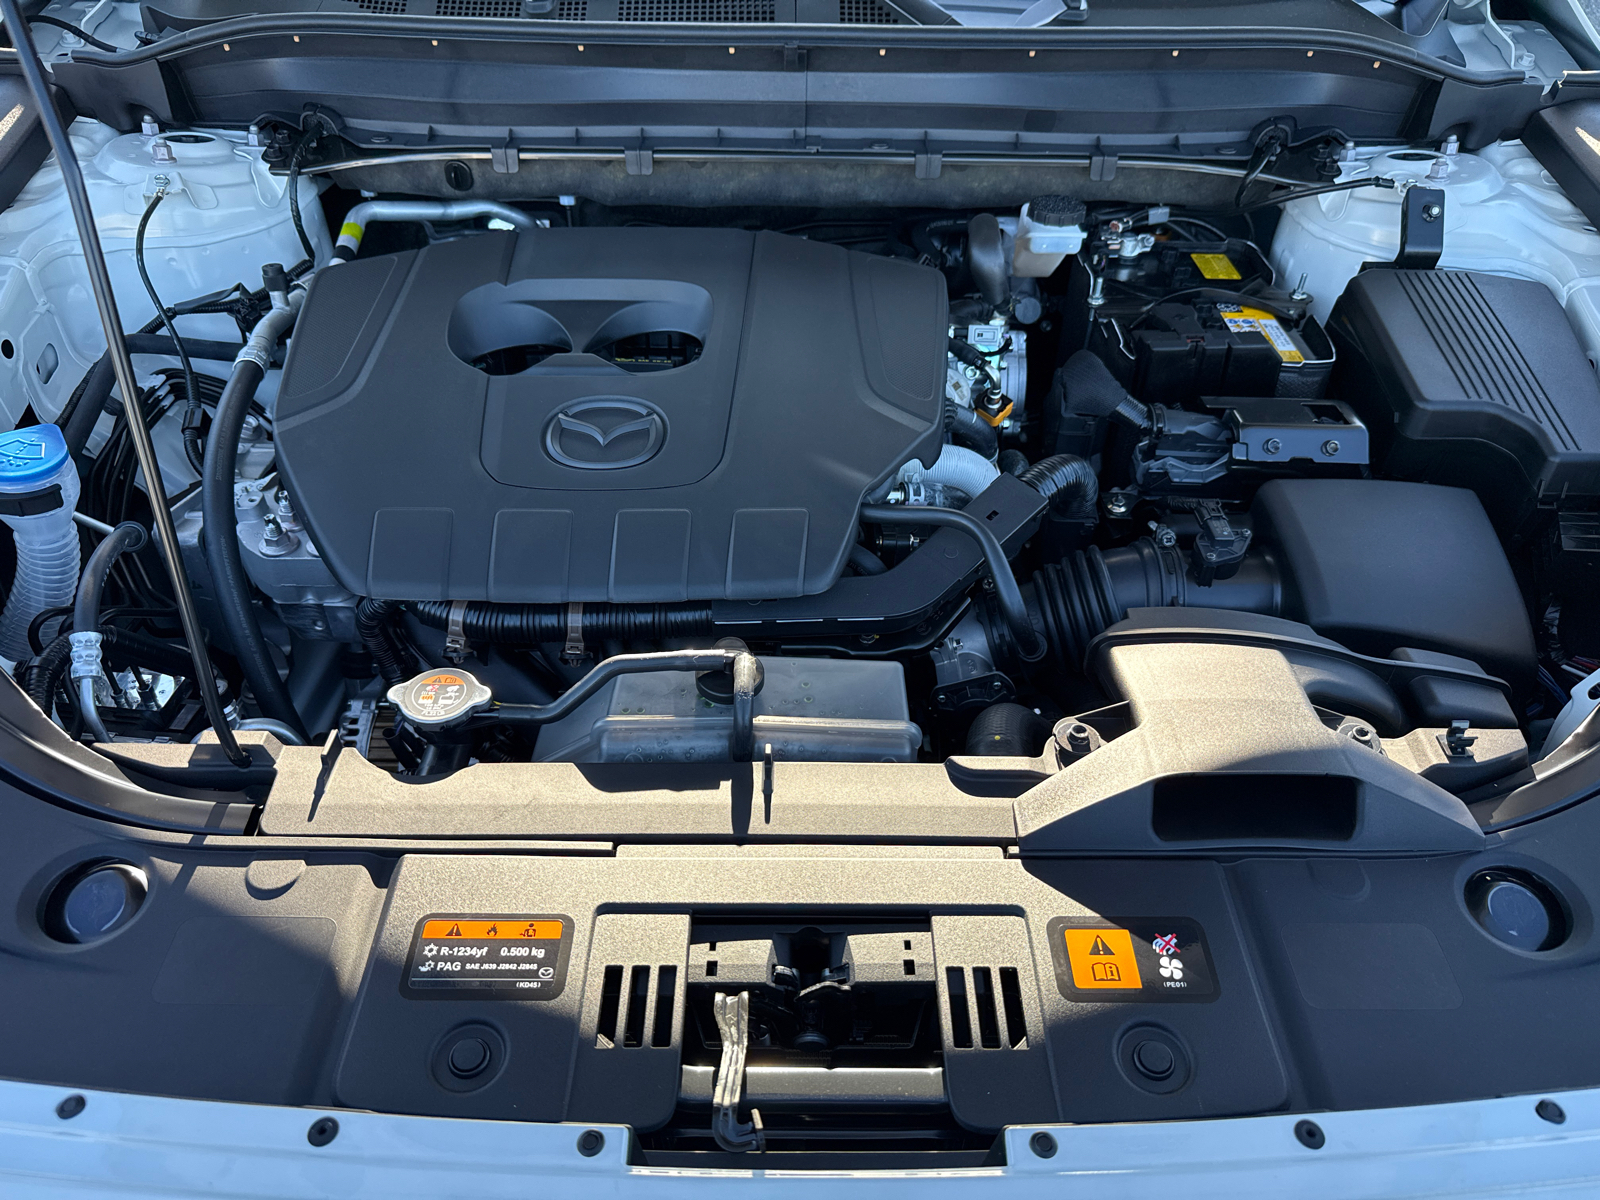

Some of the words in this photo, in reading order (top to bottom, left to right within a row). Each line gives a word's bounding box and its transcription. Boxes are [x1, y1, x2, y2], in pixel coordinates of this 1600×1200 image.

[440, 946, 488, 958] R-1234yf
[500, 946, 531, 957] 0.500
[531, 946, 545, 958] kg
[436, 961, 462, 972] PAG
